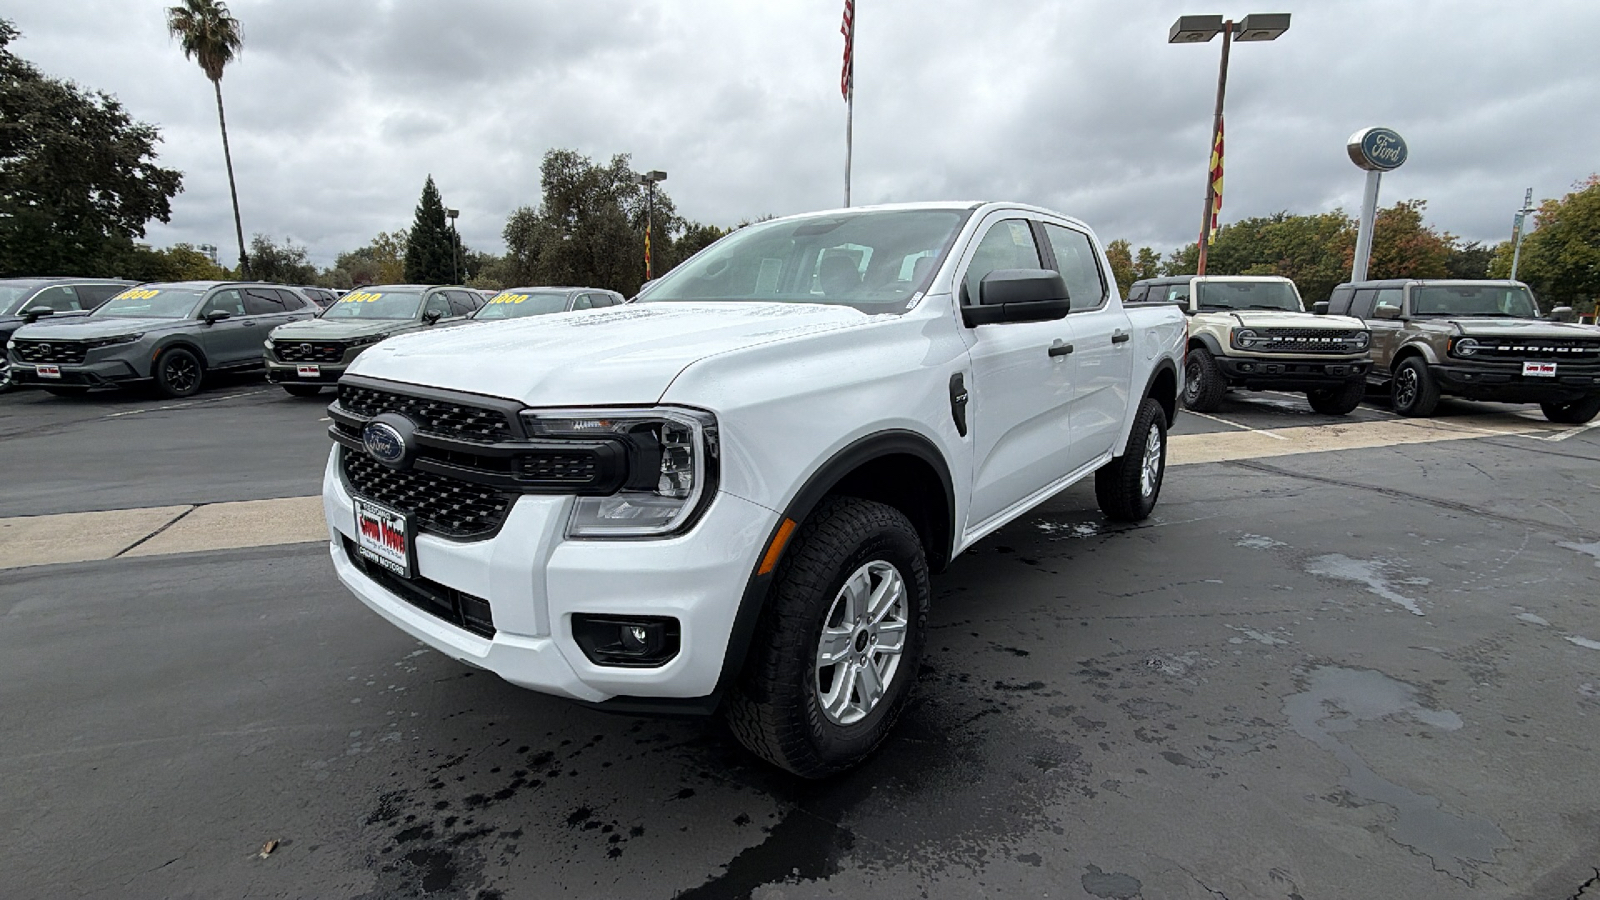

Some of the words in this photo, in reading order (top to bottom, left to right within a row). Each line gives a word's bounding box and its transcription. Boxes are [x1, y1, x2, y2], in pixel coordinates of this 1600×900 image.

[1371, 134, 1401, 162] Ford
[368, 430, 392, 455] Ford
[359, 546, 380, 563] CROWN
[379, 556, 405, 576] MOTORS
